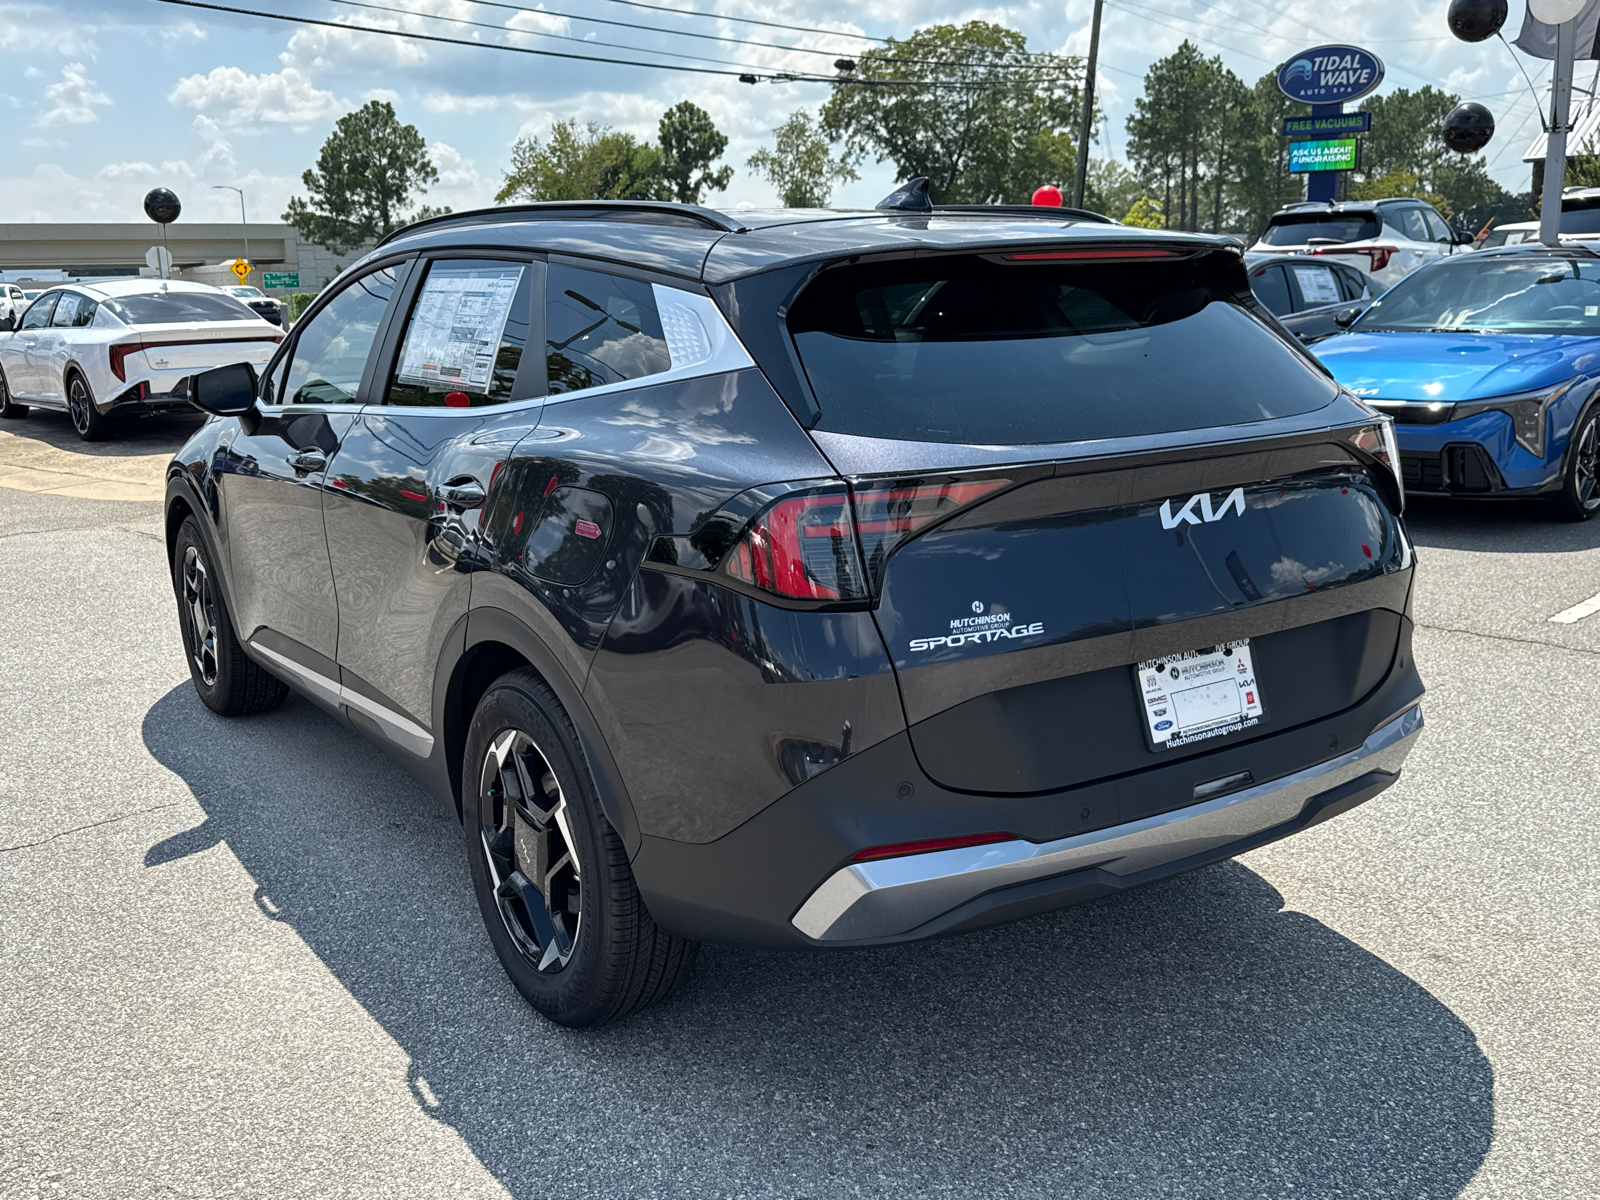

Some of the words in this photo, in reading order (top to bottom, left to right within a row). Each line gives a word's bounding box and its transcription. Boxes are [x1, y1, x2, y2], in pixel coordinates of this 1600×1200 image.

[1313, 54, 1361, 71] TIDAL
[1320, 69, 1371, 86] WAVE
[1300, 88, 1326, 96] AUTO
[1286, 120, 1312, 131] FREE
[1314, 116, 1363, 129] VACUUMS
[1292, 149, 1310, 157] ASK
[1310, 147, 1322, 156] US
[1323, 146, 1353, 155] ABOUT
[1292, 154, 1351, 164] FUNDRAISING
[1159, 487, 1246, 530] KIA
[950, 613, 1011, 629] HUTCHINSON
[952, 624, 989, 635] AUTOMOTIVE
[989, 621, 1010, 629] GROUP
[909, 622, 1045, 652] SPORTAGE
[1138, 653, 1182, 671] HUTCHINSON
[1226, 638, 1250, 650] GROUP
[1184, 669, 1212, 680] AUTOMOTIVE
[1239, 678, 1255, 688] KIA
[1147, 695, 1167, 704] GMC
[1157, 721, 1171, 730] Ford
[1165, 717, 1259, 749] Hutchinsonautogroup.com
